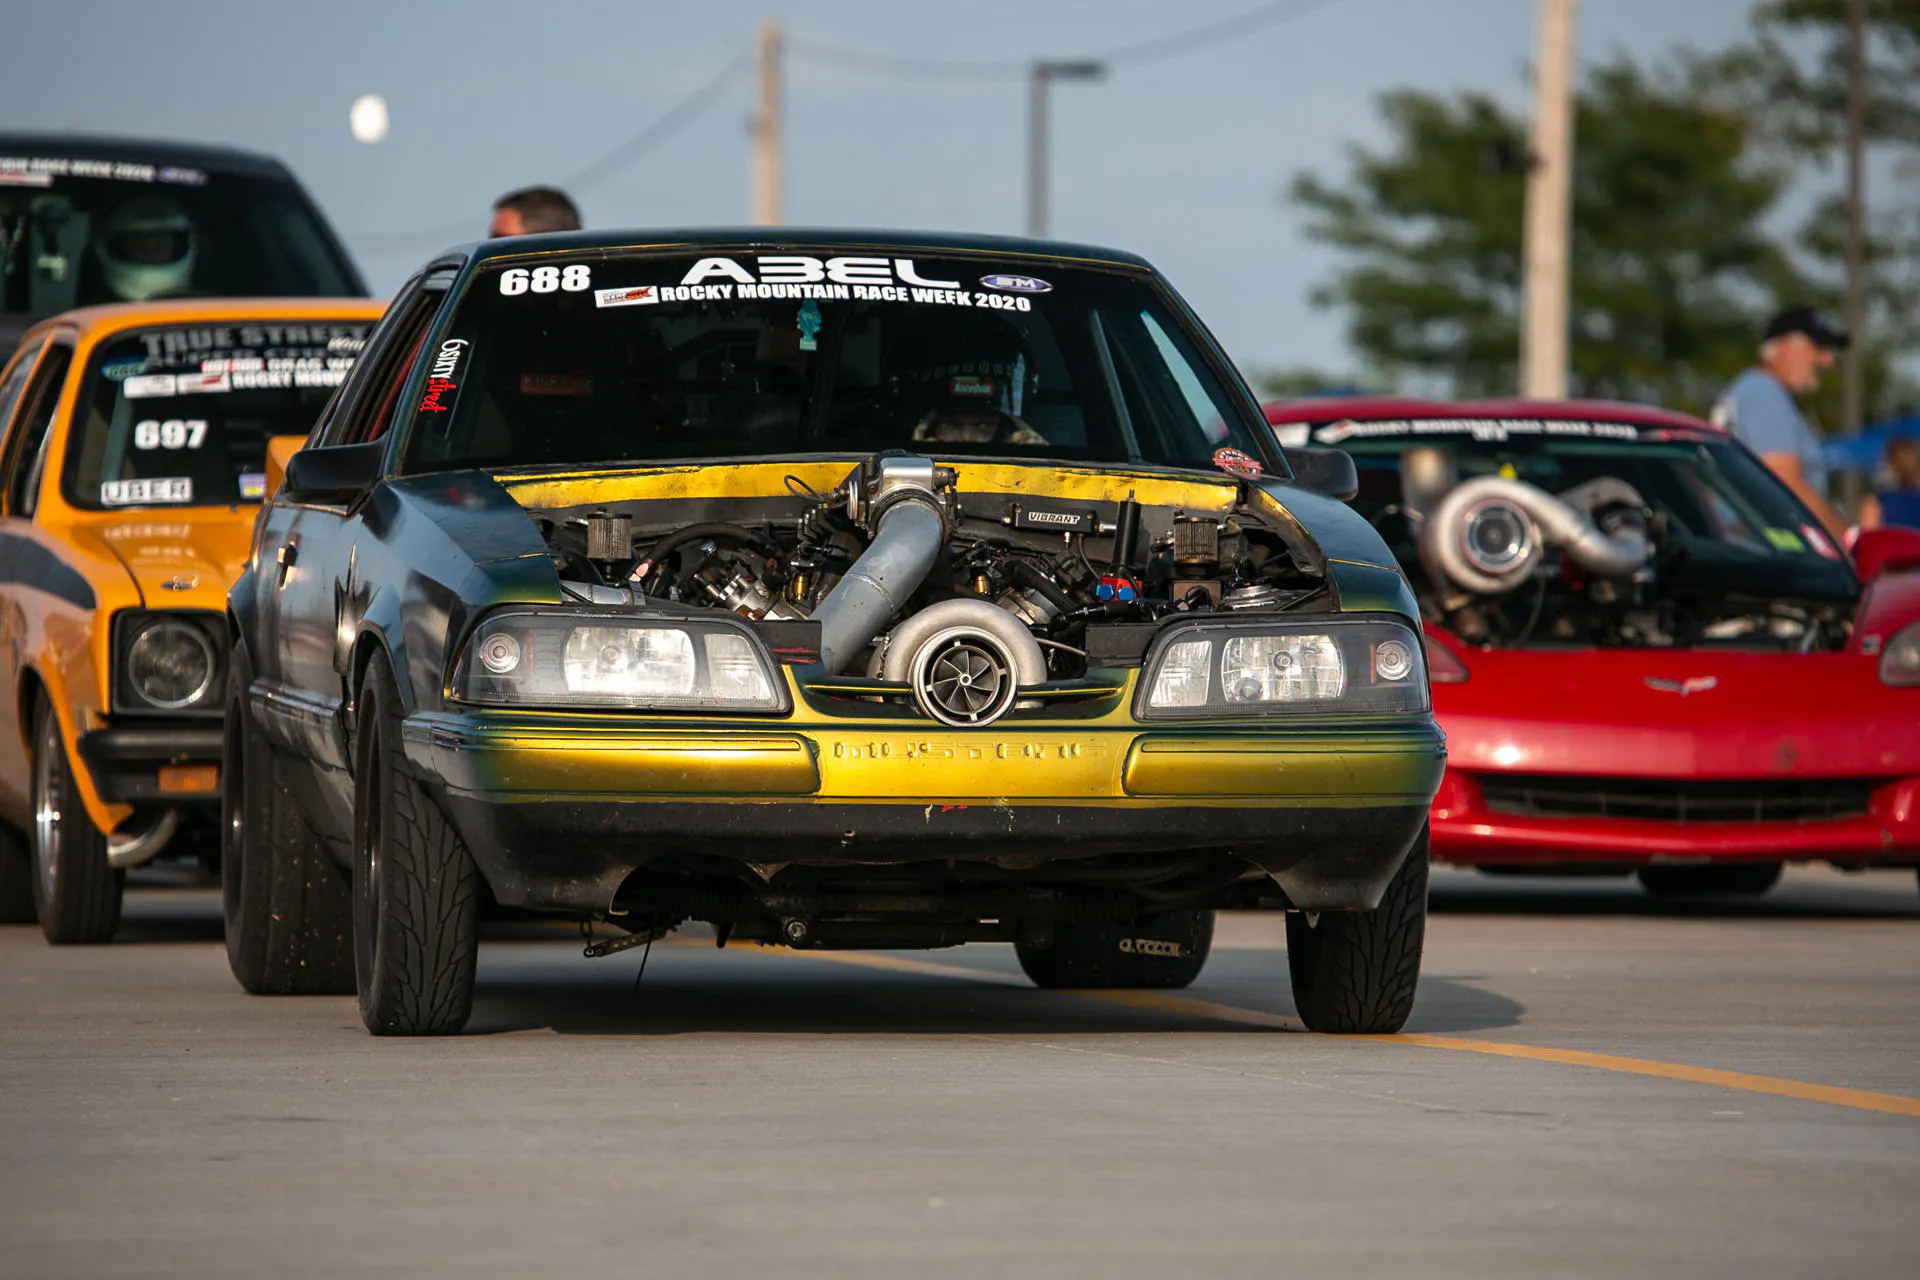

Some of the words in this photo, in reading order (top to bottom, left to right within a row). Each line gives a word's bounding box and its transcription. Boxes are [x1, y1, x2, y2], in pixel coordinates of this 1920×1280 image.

[500, 265, 591, 296] 688
[681, 256, 961, 289] ABEL
[660, 284, 734, 302] ROCKY
[737, 283, 850, 301] MOUNTAIN
[853, 285, 909, 302] RACE
[911, 287, 973, 307] WEEK
[974, 292, 1032, 312] 2020
[135, 419, 209, 449] 697
[1029, 512, 1080, 524] VIBRANT
